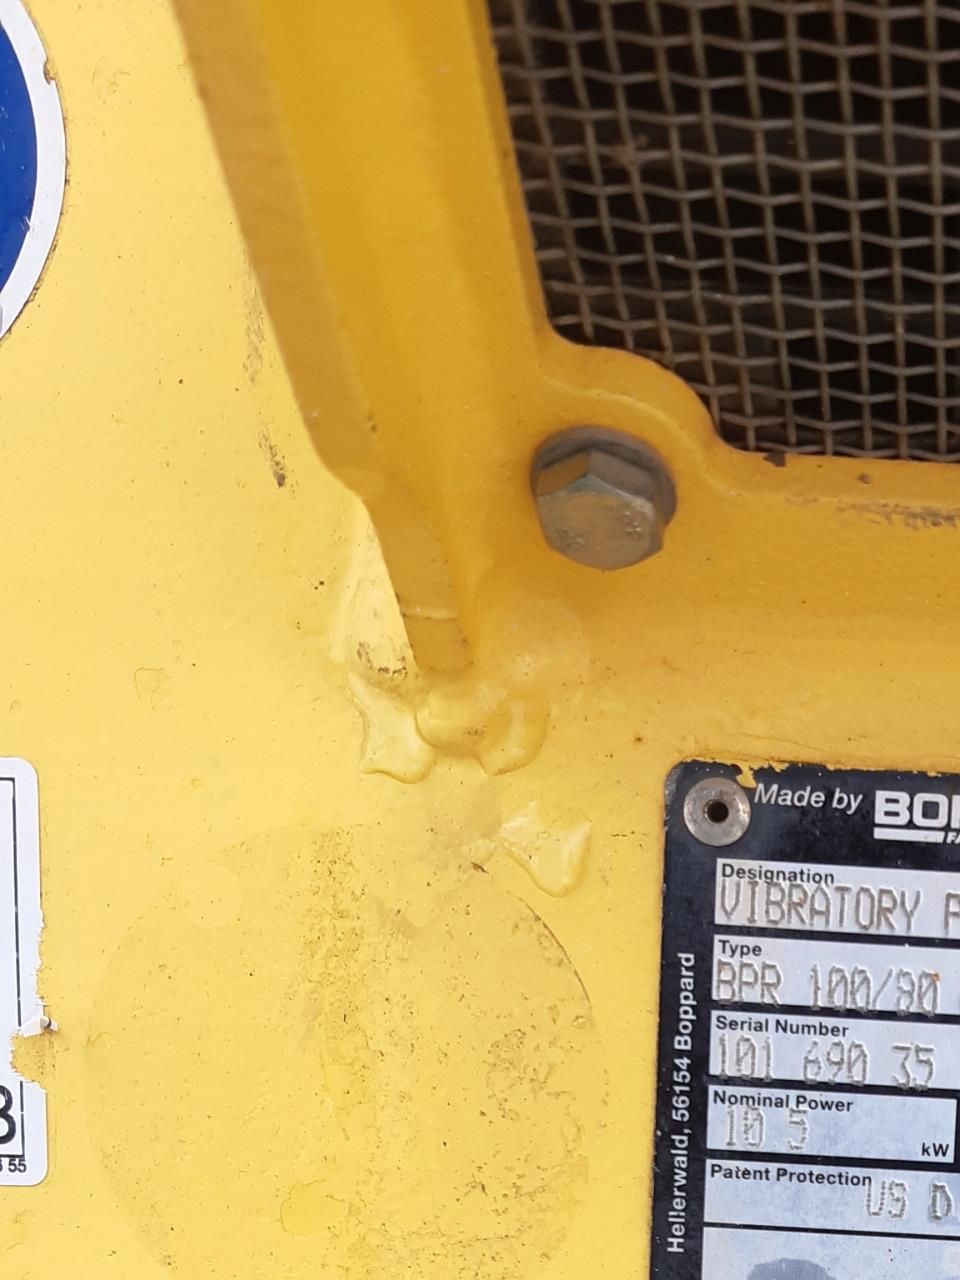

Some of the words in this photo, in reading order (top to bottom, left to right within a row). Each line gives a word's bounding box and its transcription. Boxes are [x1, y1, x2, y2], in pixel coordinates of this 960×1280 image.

[754, 783, 825, 808] Made
[831, 788, 863, 815] by
[720, 863, 835, 885] Designation
[719, 880, 921, 934] VIBRATORY
[718, 940, 763, 957] Type
[675, 952, 696, 1051] Boppard
[717, 957, 782, 1007] BPR
[810, 963, 942, 1017] 100/80
[715, 1015, 770, 1034] Serial
[774, 1019, 850, 1038] Number
[716, 1033, 773, 1082] 101
[803, 1039, 867, 1086] 690
[893, 1041, 935, 1091] 35
[671, 1057, 690, 1122] 56154
[713, 1090, 790, 1109] Nominal
[796, 1095, 854, 1112] Power
[921, 1142, 951, 1157] kW
[8, 1159, 27, 1173] 55
[710, 1163, 771, 1181] Patent
[776, 1168, 872, 1187] Protection
[667, 1126, 692, 1253] Hellerwald,
[932, 1181, 955, 1222] D
